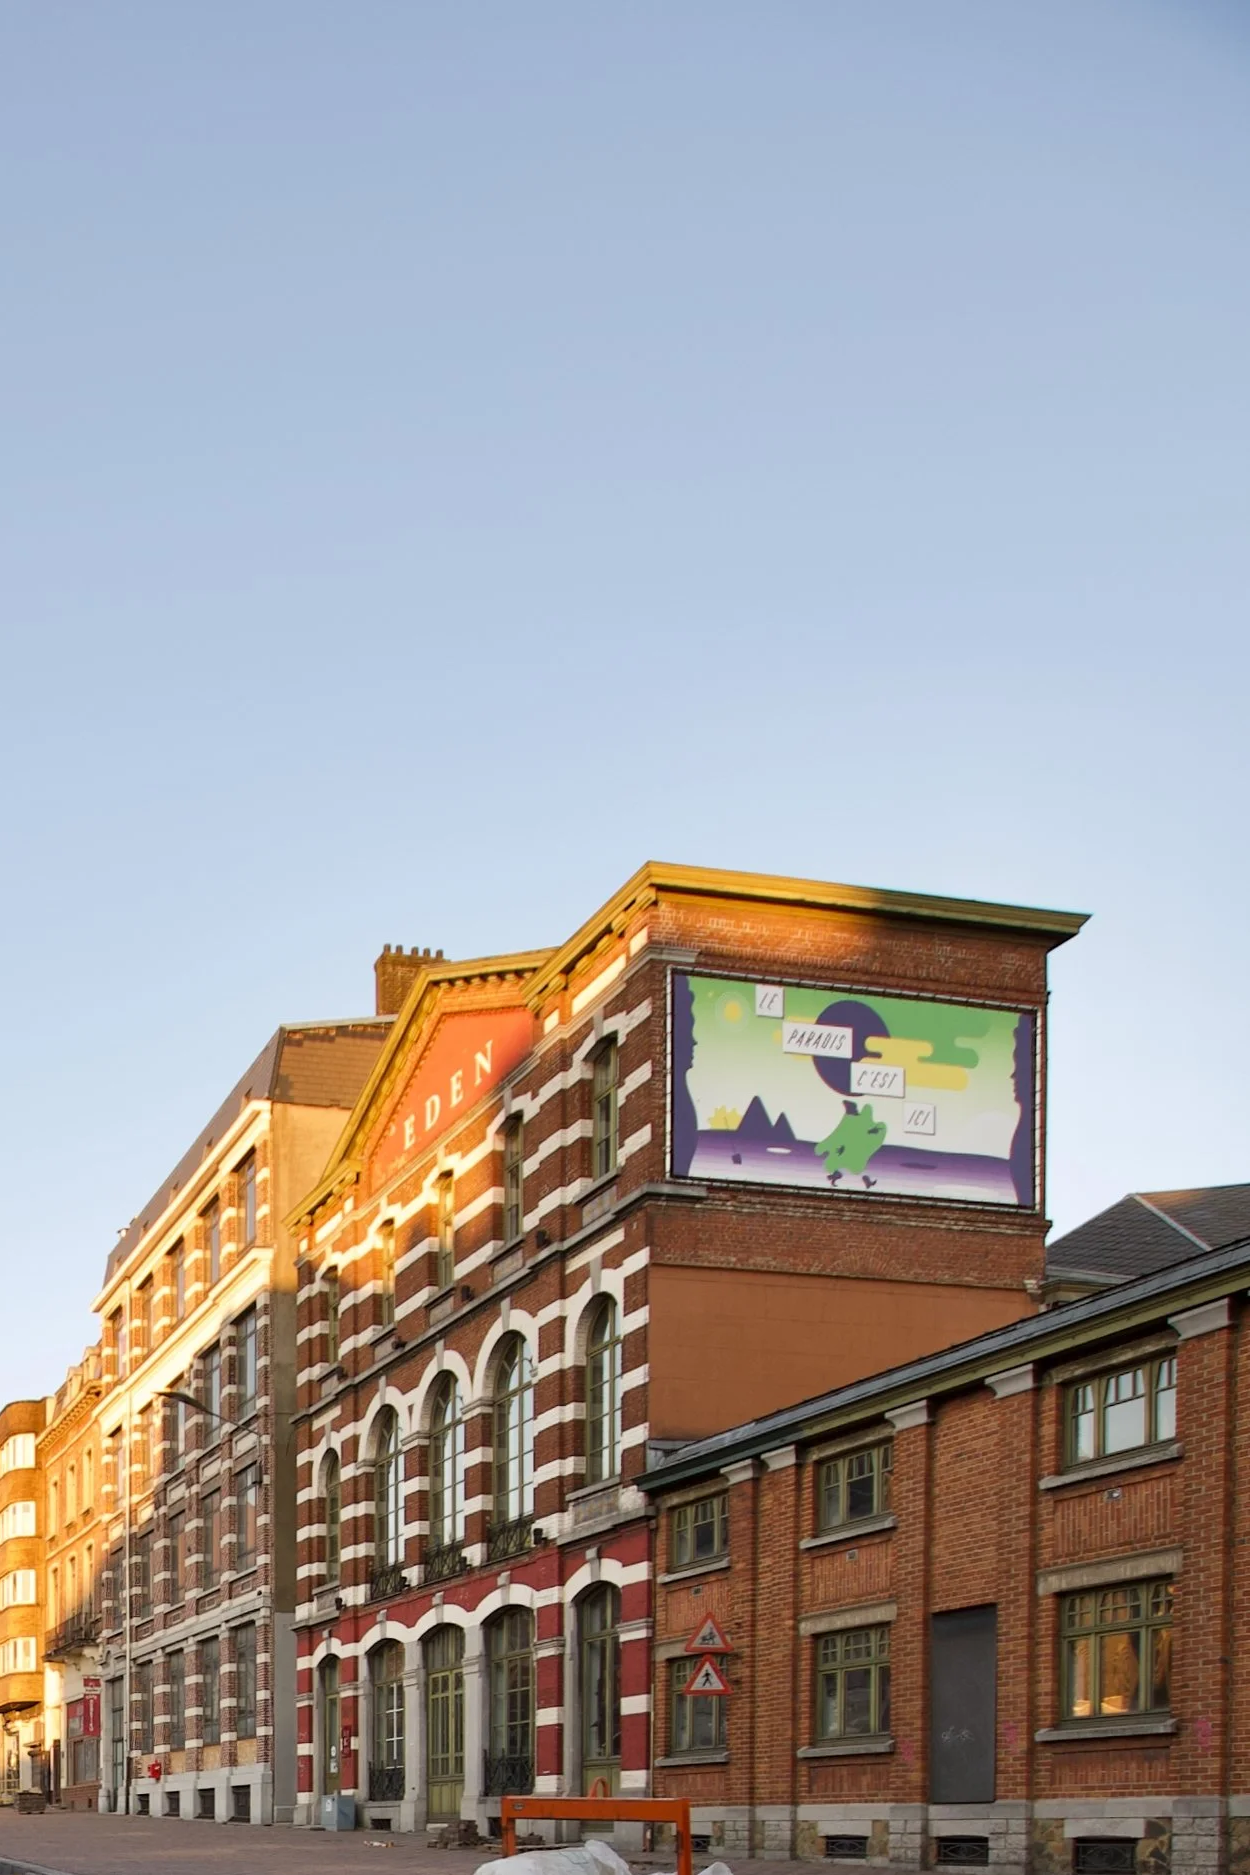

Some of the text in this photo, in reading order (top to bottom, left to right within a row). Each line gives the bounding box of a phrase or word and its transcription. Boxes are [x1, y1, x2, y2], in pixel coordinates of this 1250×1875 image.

[759, 992, 775, 1011] LE
[788, 1030, 847, 1051] PARADIS
[857, 1070, 897, 1089] C'EST
[403, 1039, 493, 1150] EDEN
[908, 1109, 930, 1129] ICI
